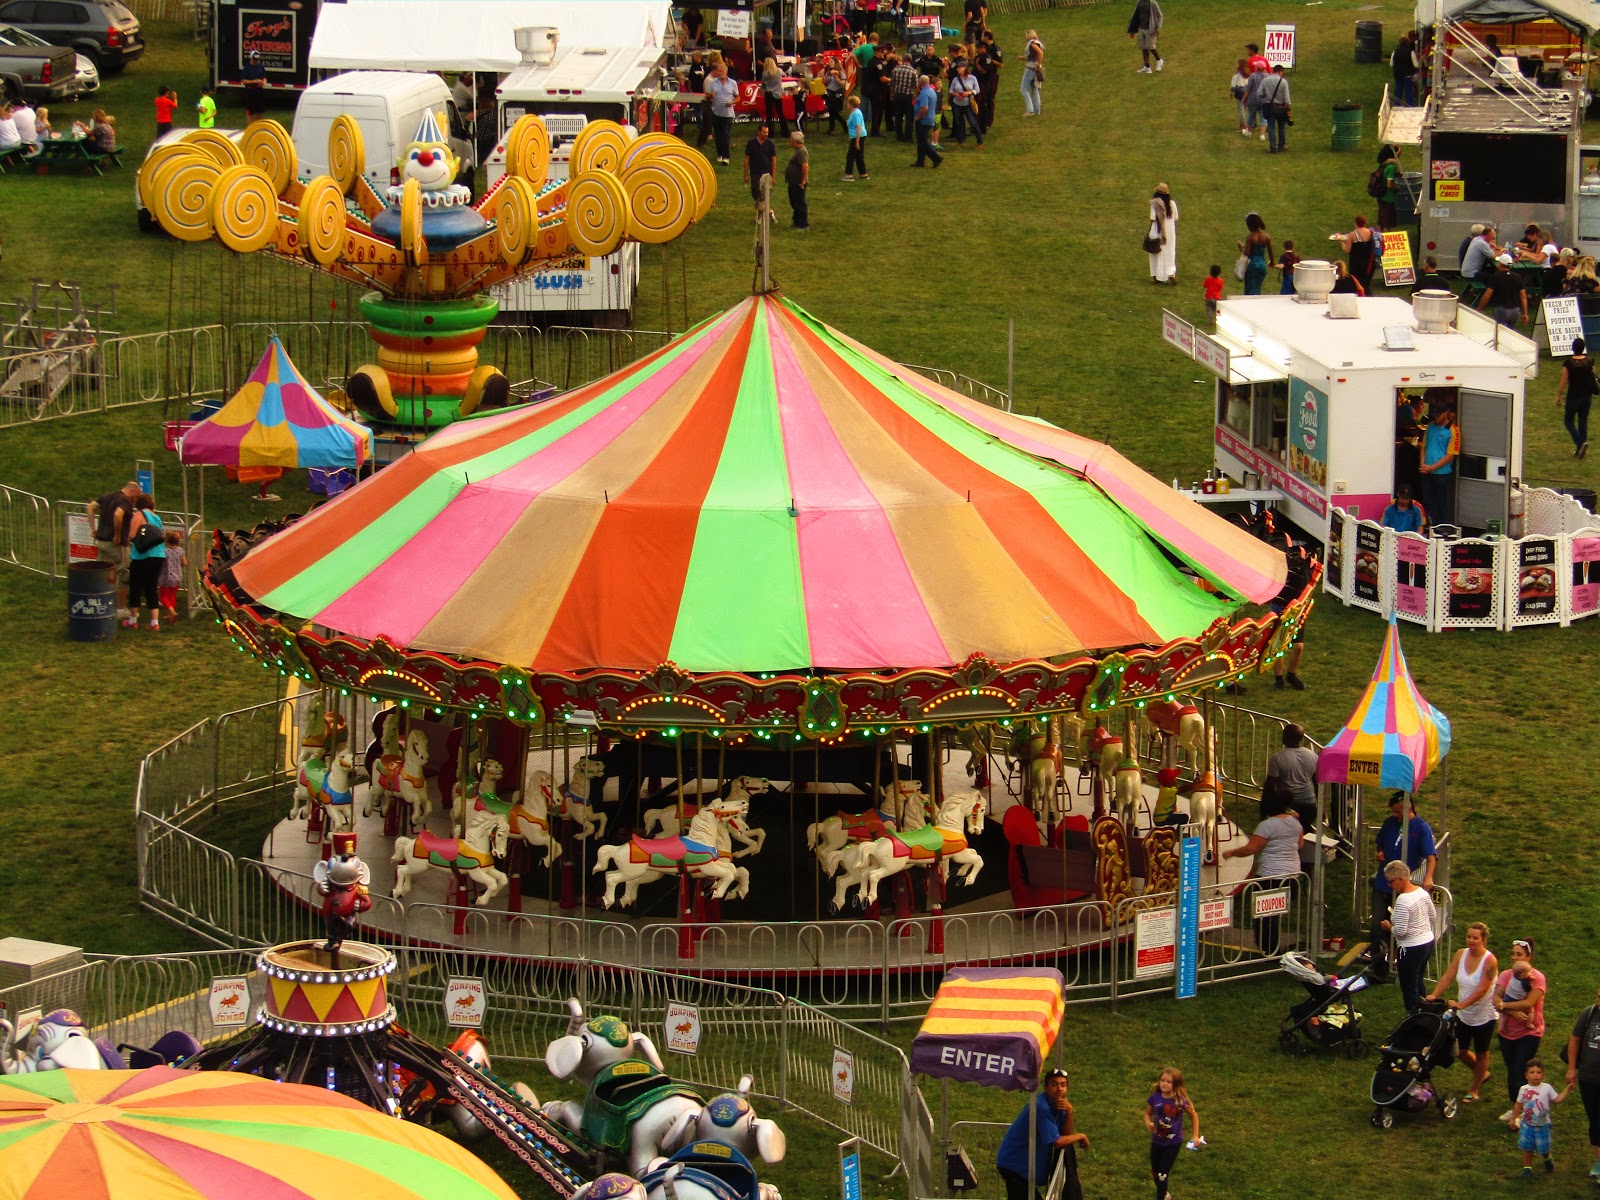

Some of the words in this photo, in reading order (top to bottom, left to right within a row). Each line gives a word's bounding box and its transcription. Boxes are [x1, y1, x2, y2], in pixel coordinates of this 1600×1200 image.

[244, 40, 292, 52] CATERING
[1267, 33, 1292, 50] ATM
[1266, 53, 1290, 61] INSIDE
[1382, 234, 1406, 243] UNNEL
[534, 275, 582, 290] SLUSH
[1349, 760, 1379, 774] ENTER
[1257, 901, 1260, 912] 2
[1262, 896, 1284, 911] COUPONS
[1182, 907, 1187, 919] UP
[1199, 920, 1214, 928] EQUIRED
[1214, 917, 1229, 926] COUPONS
[214, 982, 245, 992] JUMPING
[450, 983, 480, 992] JUMPING
[450, 1013, 480, 1022] JUMBO
[670, 1008, 696, 1020] JUMPING
[941, 1046, 1015, 1075] ENTER
